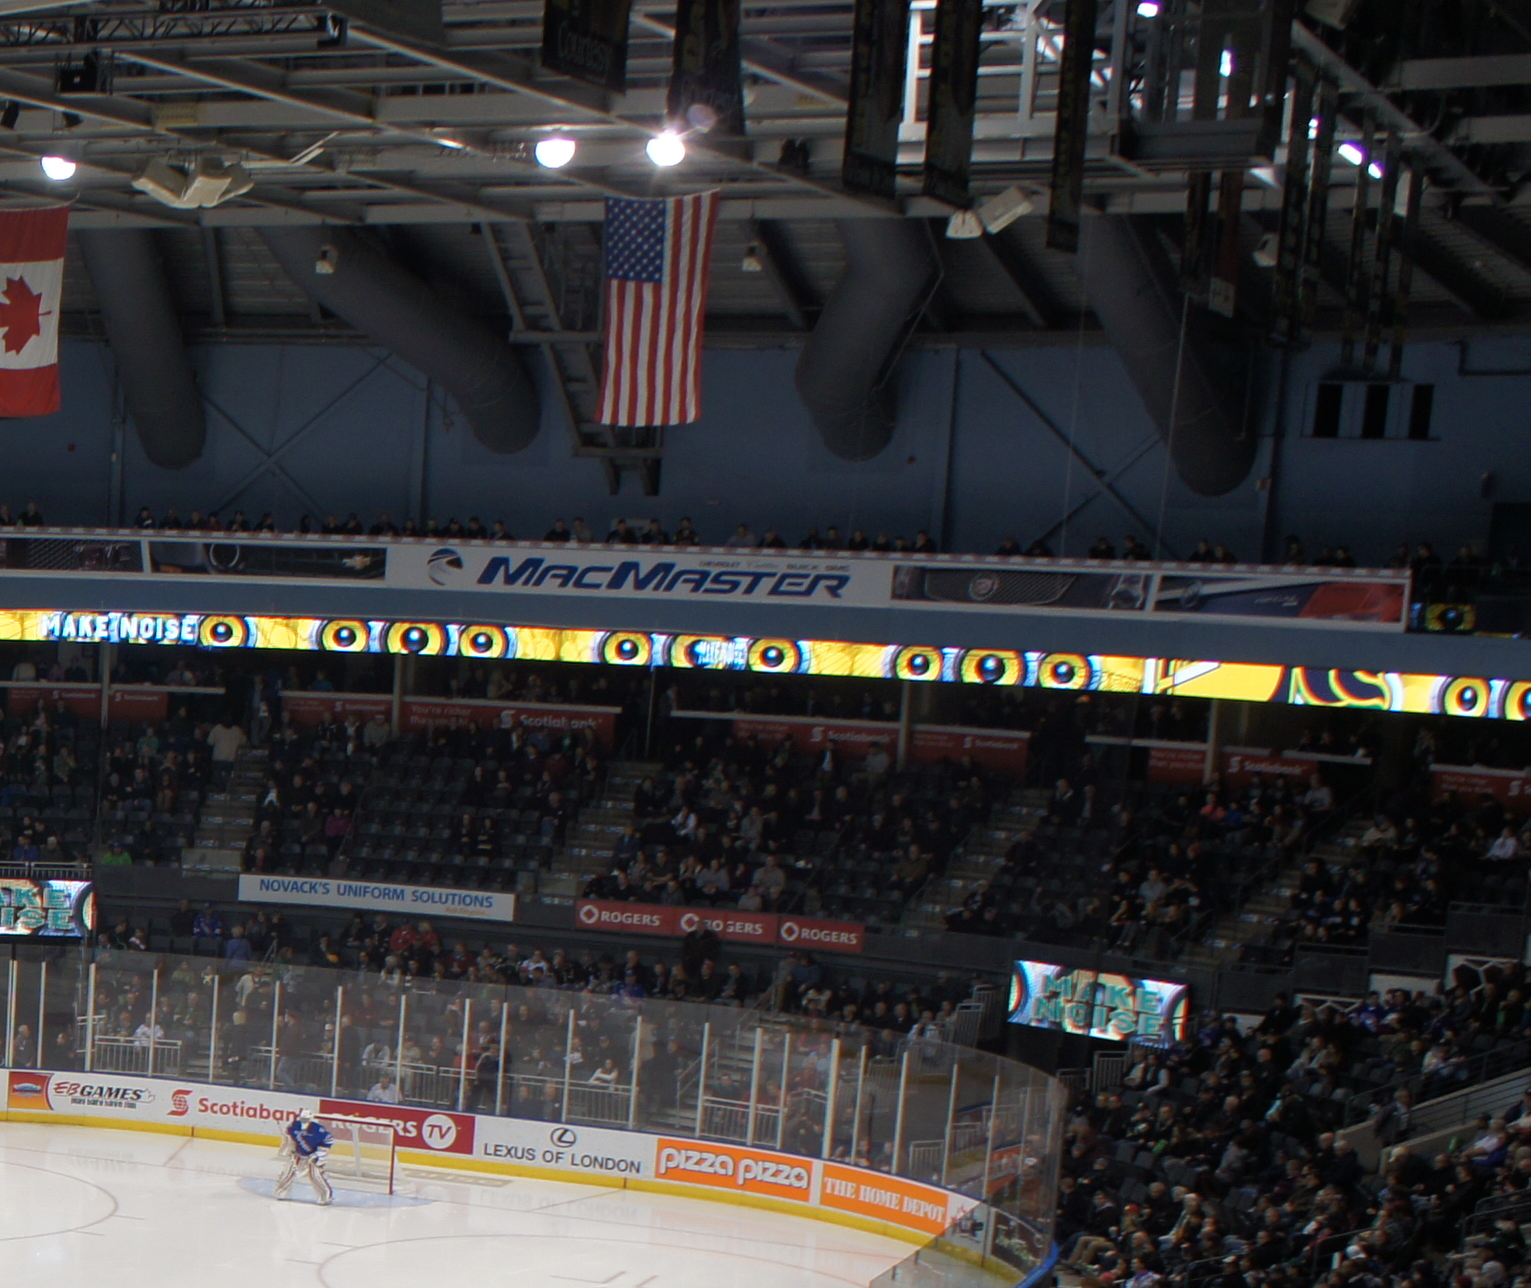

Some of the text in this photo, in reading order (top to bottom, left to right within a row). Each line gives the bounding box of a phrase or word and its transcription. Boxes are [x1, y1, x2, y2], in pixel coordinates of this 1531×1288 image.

[477, 556, 853, 598] MACMASTER
[260, 879, 493, 908] NOVACK'S UNIFORM SOLUTIONS
[600, 910, 661, 926] ROGERS
[801, 928, 858, 945] ROGERS
[80, 1083, 147, 1102] GAMES
[426, 1122, 451, 1141] TV
[484, 1142, 642, 1174] LEXUS OF LONDON
[659, 1146, 810, 1190] pizza pizza
[824, 1176, 947, 1224] THE HOME DEPOT
